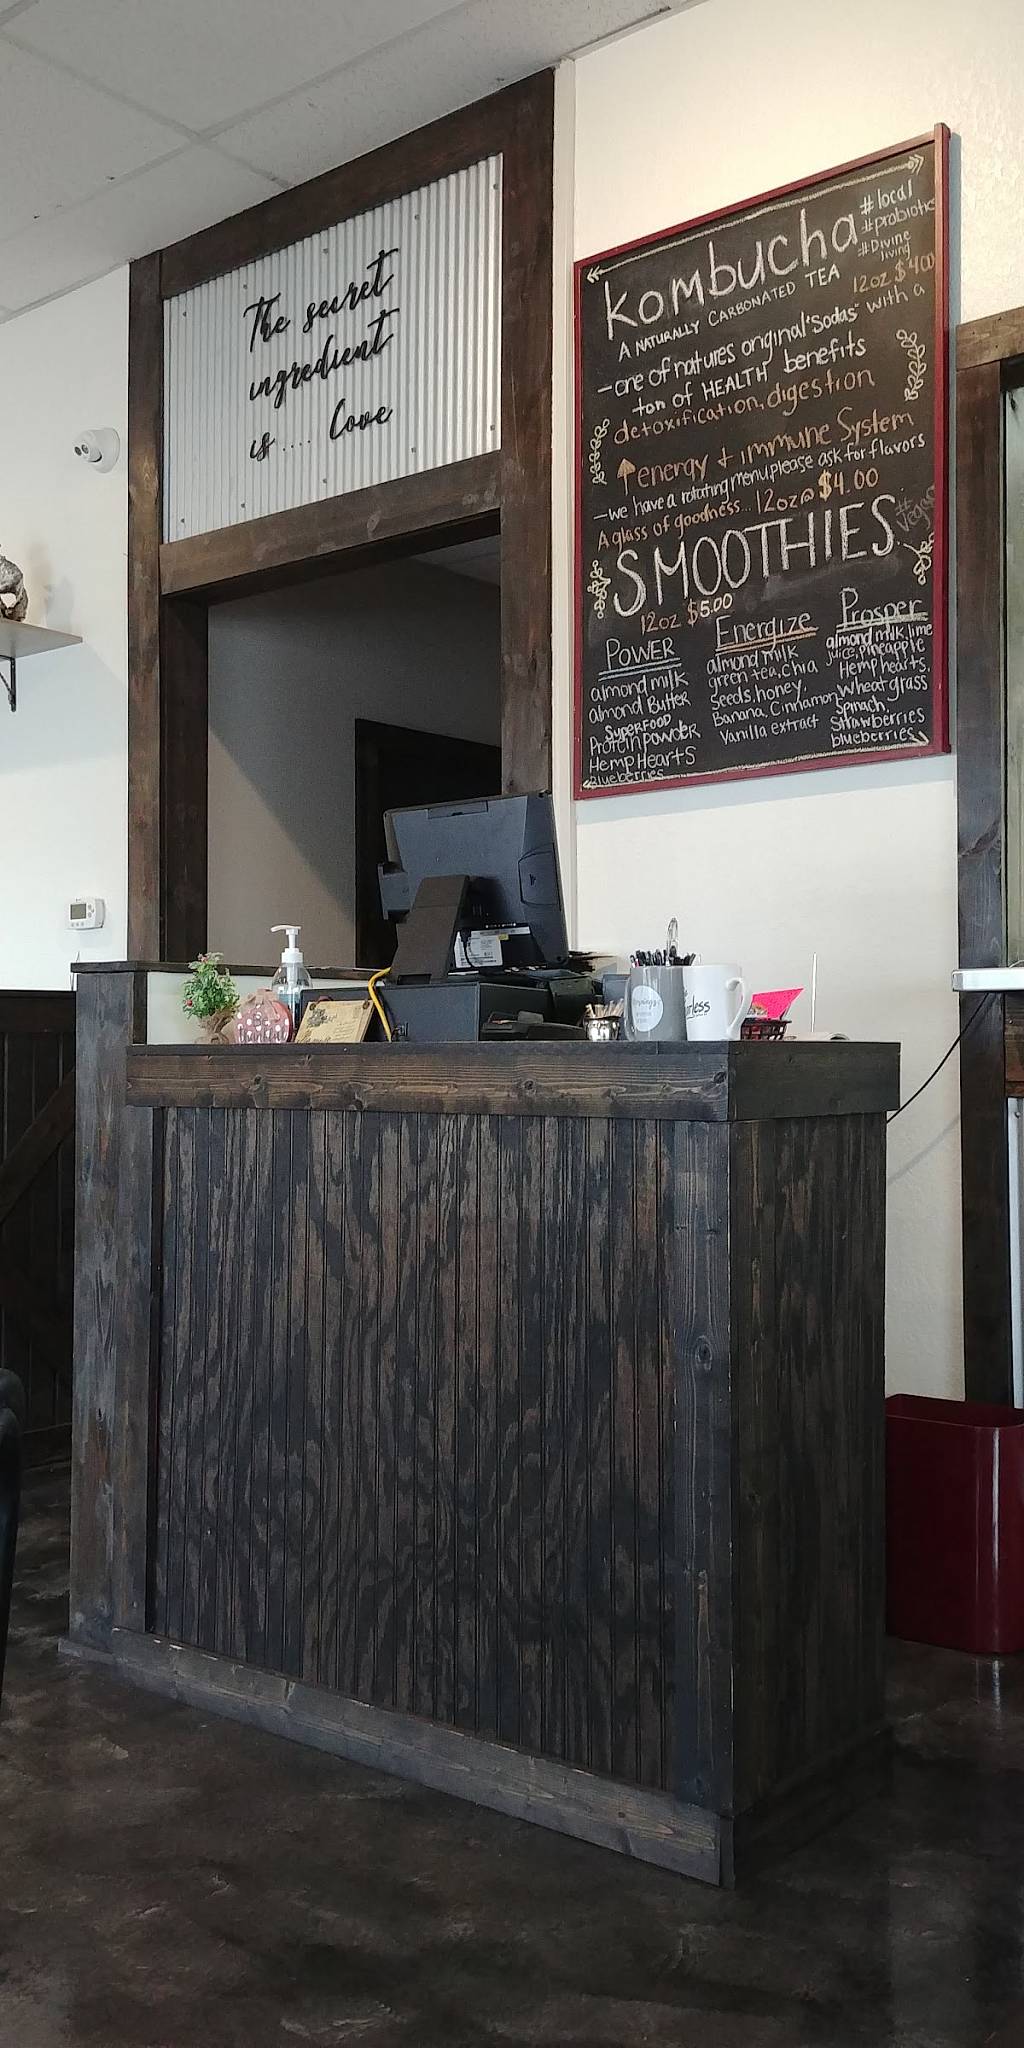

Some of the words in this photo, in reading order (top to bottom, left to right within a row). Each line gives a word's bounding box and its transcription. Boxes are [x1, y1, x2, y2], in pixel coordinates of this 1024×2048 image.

[880, 242, 910, 261] living
[243, 292, 290, 352] The
[303, 248, 398, 333] secret
[853, 271, 891, 293] 12oz
[619, 341, 632, 363] A
[635, 320, 701, 357] NATURALLY
[708, 281, 796, 327] CARBONATED
[805, 264, 840, 289] TEA
[649, 357, 670, 387] of
[674, 342, 736, 379] natures
[741, 311, 806, 365] original
[866, 285, 908, 314] with
[913, 283, 925, 297] a
[250, 308, 400, 408] ingredient
[631, 397, 666, 417] ton
[672, 381, 693, 408] of
[702, 363, 769, 401] HEALTH
[783, 330, 867, 374] benefits
[767, 369, 876, 417] digestion
[637, 454, 709, 488] energy
[741, 423, 832, 464] immune
[837, 406, 914, 446] System
[633, 495, 664, 517] have
[666, 493, 677, 508] a
[681, 478, 729, 505] rotating
[818, 447, 842, 467] ask
[844, 441, 866, 462] for
[868, 432, 925, 460] flavors
[598, 530, 610, 552] A
[611, 525, 648, 552] glass
[653, 514, 670, 537] of
[818, 467, 879, 501] $4.00
[614, 494, 896, 617] SMOOTHIES
[641, 611, 681, 635] 12oz
[687, 593, 733, 628] $5.00
[840, 587, 922, 633] Prosper
[716, 612, 812, 651] Energize
[826, 626, 872, 650] almond
[908, 624, 933, 639] lime
[860, 638, 925, 661] pineapple
[707, 650, 758, 675] almond
[762, 644, 799, 665] milk
[840, 657, 877, 680] Hemp
[591, 674, 649, 702] almond
[651, 669, 689, 691] milk
[708, 670, 748, 696] green
[589, 696, 643, 724] almond
[720, 725, 767, 745] Vanilla
[771, 714, 819, 735] extract
[831, 727, 913, 748] blueberries
[589, 753, 635, 774] Hemp
